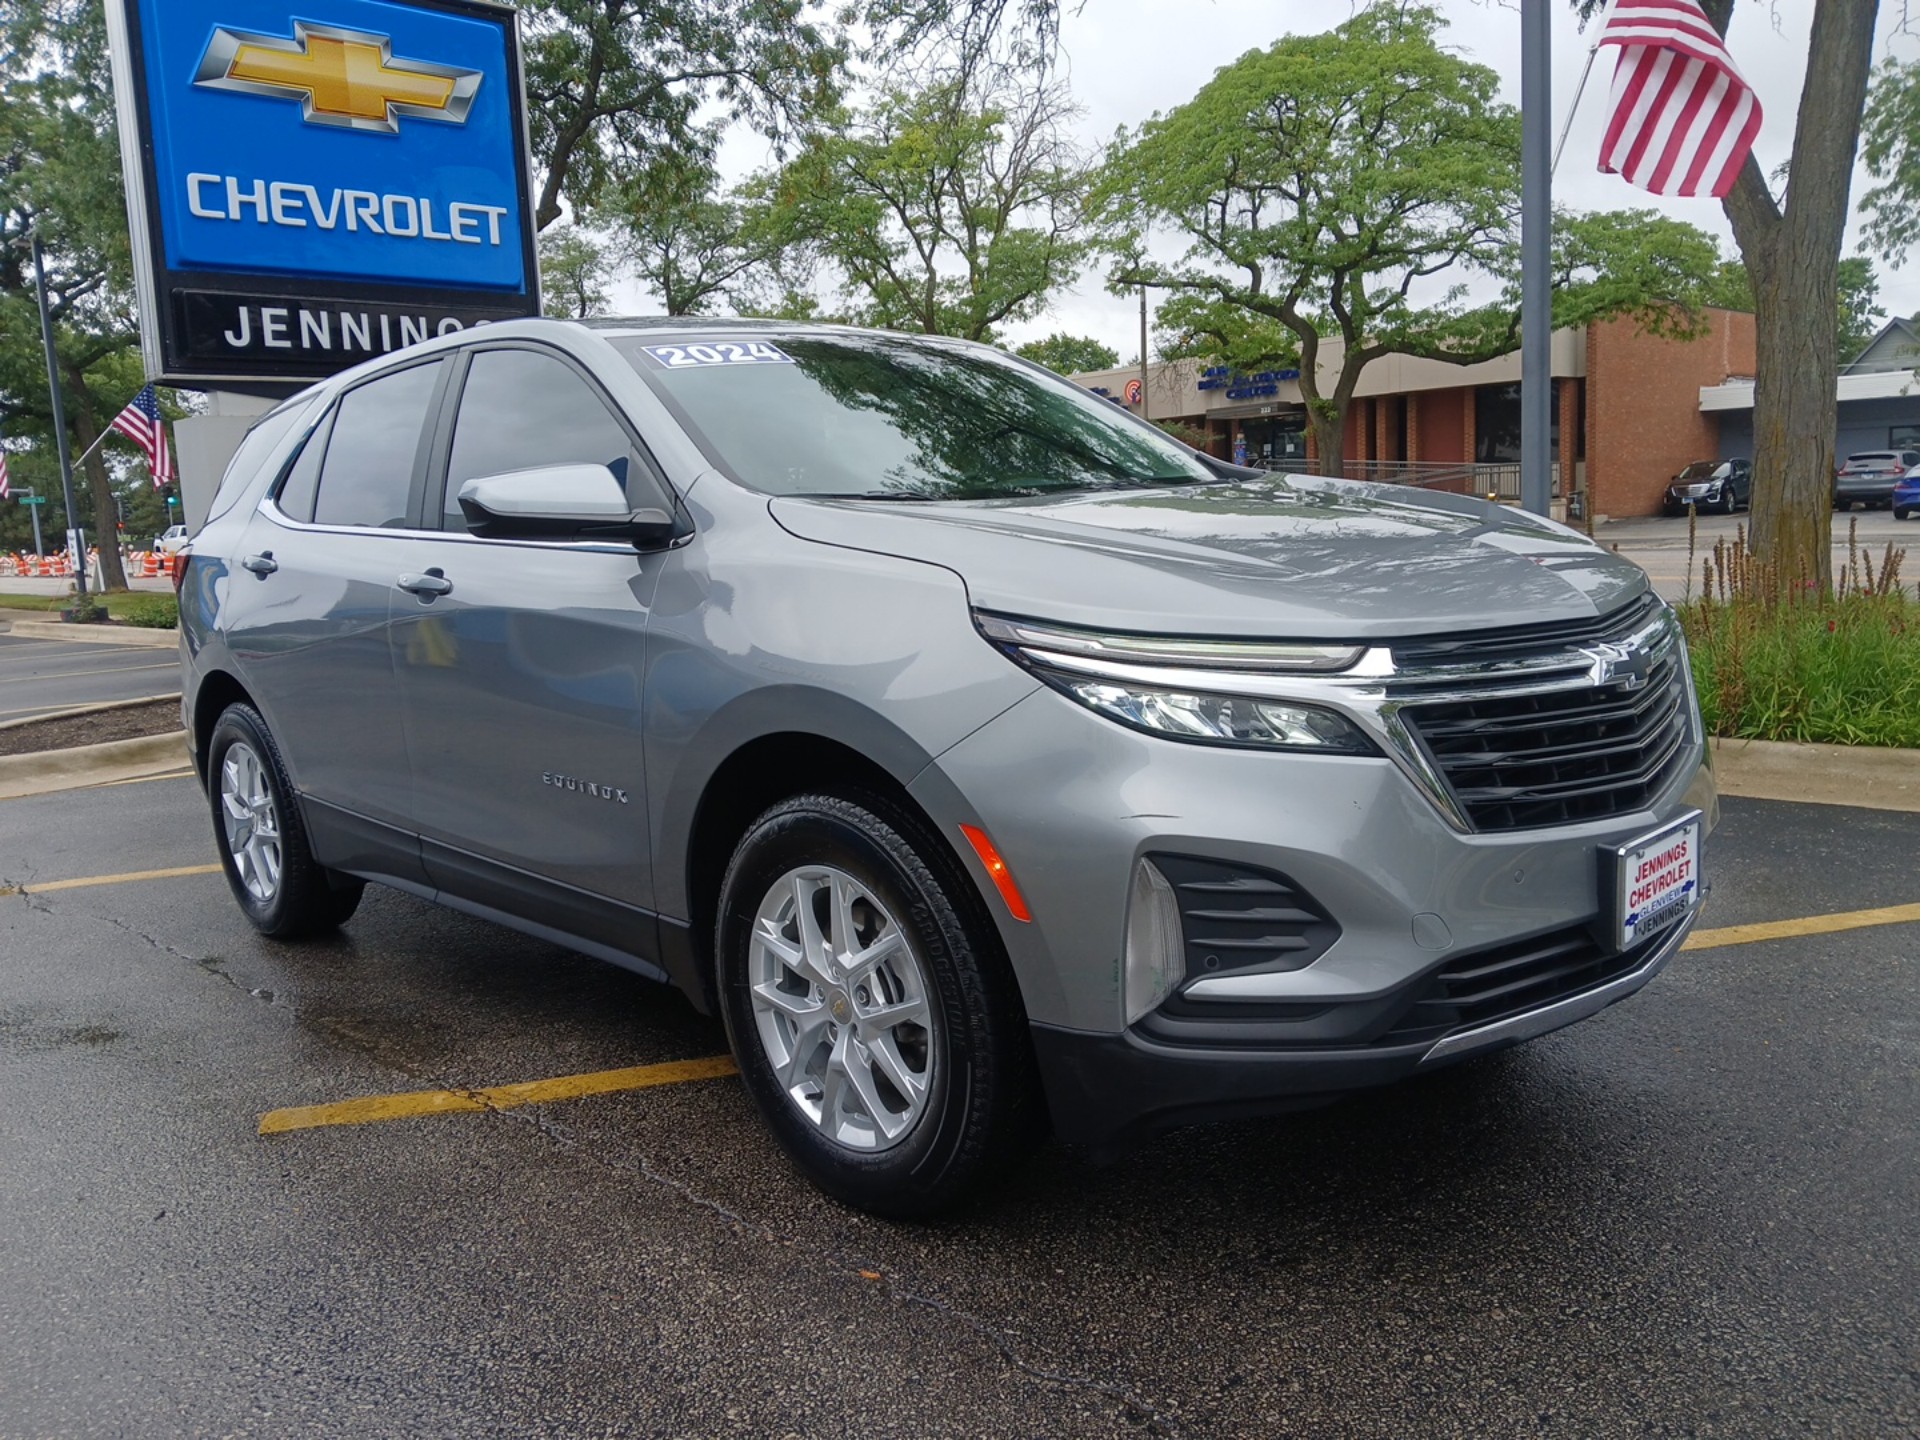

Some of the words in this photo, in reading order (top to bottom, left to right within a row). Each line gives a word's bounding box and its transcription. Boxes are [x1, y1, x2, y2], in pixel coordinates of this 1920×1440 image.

[187, 173, 506, 245] CHEVROLET
[225, 307, 493, 351] JENNIN
[657, 344, 782, 366] 2024
[542, 771, 628, 804] EQUINOX
[1635, 841, 1688, 884] JENNINGS
[1630, 860, 1691, 908] CHEVROLET
[1639, 887, 1682, 918] GLENVIEW
[1639, 899, 1685, 936] JENNINGS
